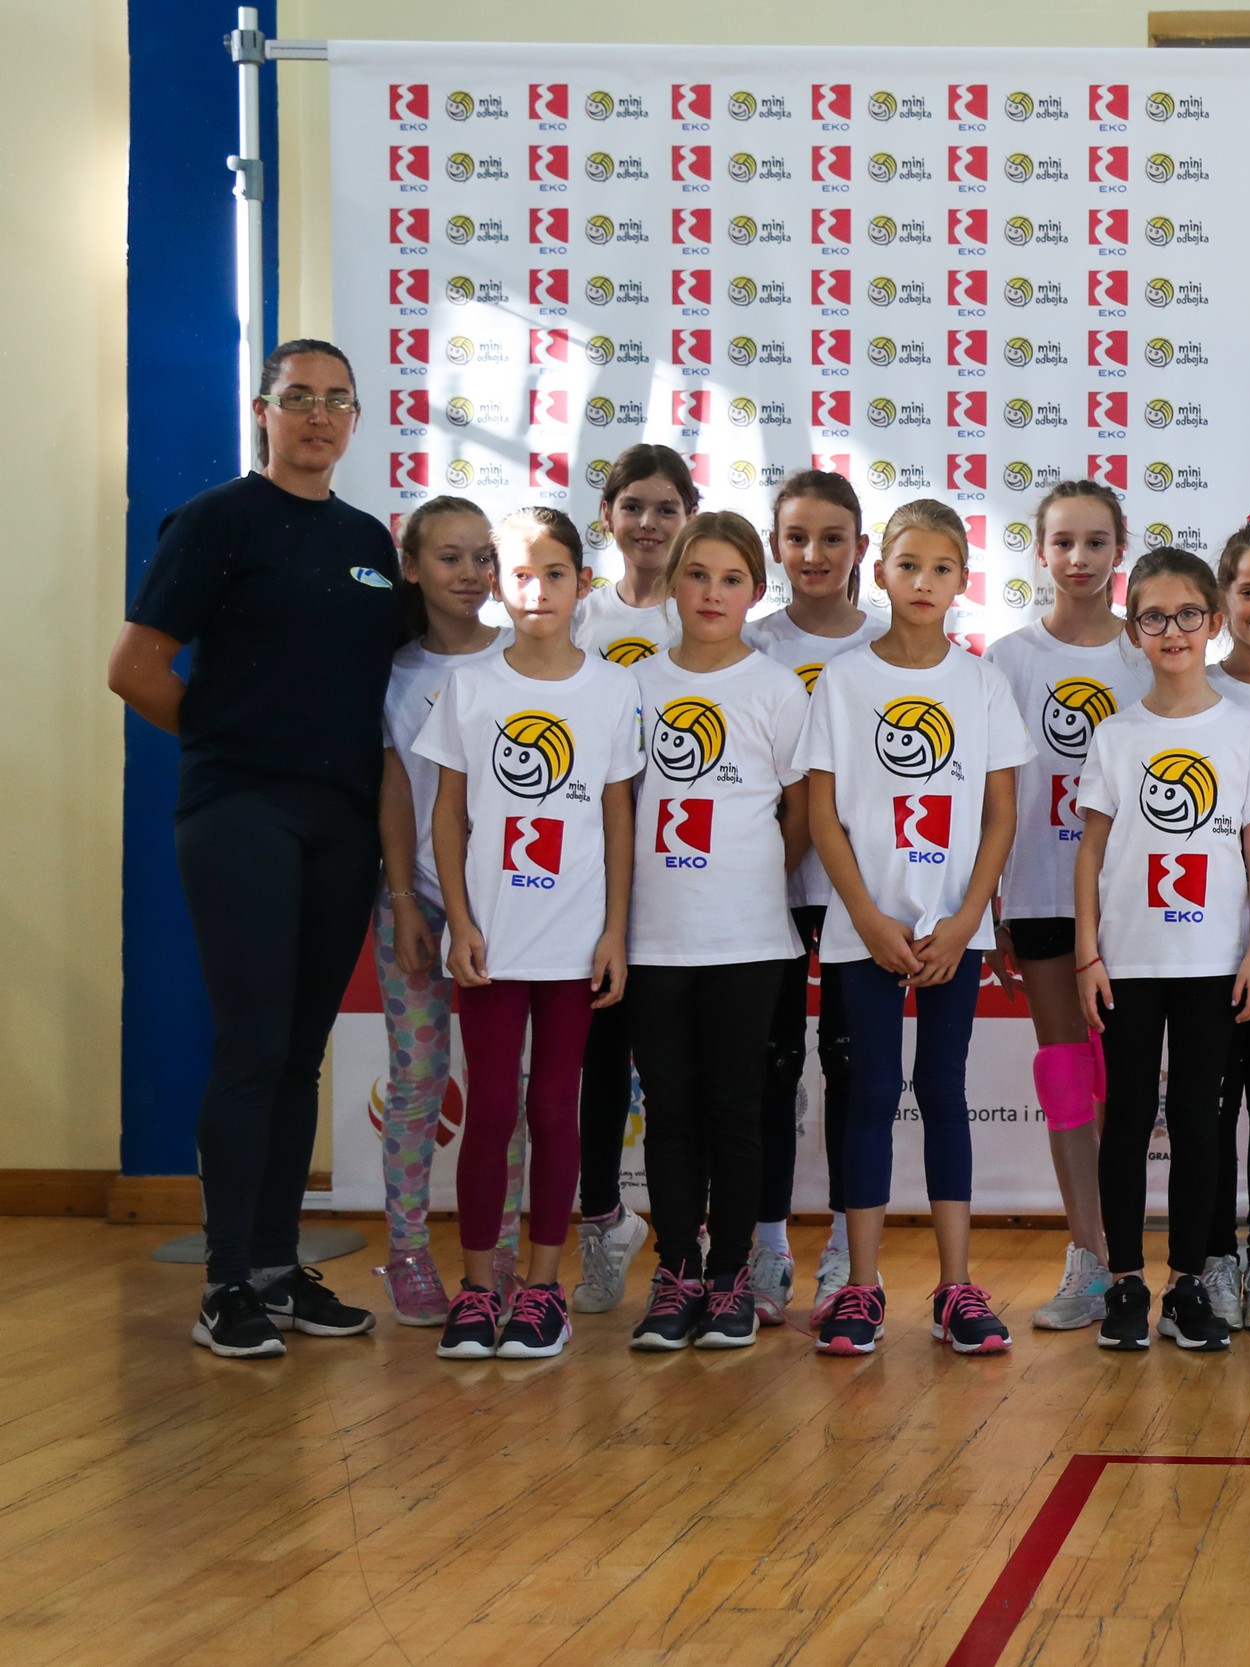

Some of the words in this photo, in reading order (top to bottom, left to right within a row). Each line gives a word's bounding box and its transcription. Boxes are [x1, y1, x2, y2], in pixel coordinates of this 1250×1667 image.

[479, 95, 501, 107] mini
[762, 95, 784, 107] mini
[1039, 96, 1061, 108] mini
[476, 107, 508, 120] odbojka
[759, 107, 791, 120] odbojka
[1036, 108, 1068, 120] odbojka
[400, 123, 428, 131] EKO
[682, 123, 710, 131] EKO
[619, 156, 641, 168] mini
[902, 157, 924, 169] mini
[1180, 157, 1202, 169] mini
[616, 168, 648, 180] odbojka
[899, 169, 931, 181] odbojka
[1177, 169, 1209, 182] odbojka
[480, 219, 502, 231] mini
[762, 219, 784, 231] mini
[1039, 220, 1061, 232] mini
[477, 231, 509, 244] odbojka
[760, 231, 791, 244] odbojka
[1036, 232, 1068, 245] odbojka
[682, 247, 711, 255] EKO
[619, 280, 642, 292] mini
[902, 281, 924, 293] mini
[1179, 281, 1201, 294] mini
[617, 292, 649, 305] odbojka
[899, 293, 931, 305] odbojka
[1176, 294, 1208, 306] odbojka
[540, 307, 568, 315] EKO
[1099, 309, 1127, 317] EKO
[762, 340, 784, 352] mini
[1038, 341, 1060, 353] mini
[759, 352, 791, 365] odbojka
[1035, 353, 1067, 366] odbojka
[400, 367, 428, 375] EKO
[901, 402, 924, 414] mini
[1179, 403, 1201, 415] mini
[899, 414, 931, 427] odbojka
[1176, 415, 1208, 427] odbojka
[822, 429, 850, 437] EKO
[1038, 465, 1060, 477] mini
[719, 762, 738, 775] mini
[716, 772, 743, 784] odbojka
[568, 780, 587, 793] mini
[566, 790, 591, 803] odbojka
[1214, 814, 1232, 827] mini
[1059, 829, 1083, 842] EK
[1212, 823, 1237, 836] odbojka
[666, 856, 707, 869] EKO
[909, 851, 945, 864] EKO
[511, 874, 556, 889] EKO
[1164, 911, 1204, 923] EKO
[1148, 1152, 1171, 1161] GRA
